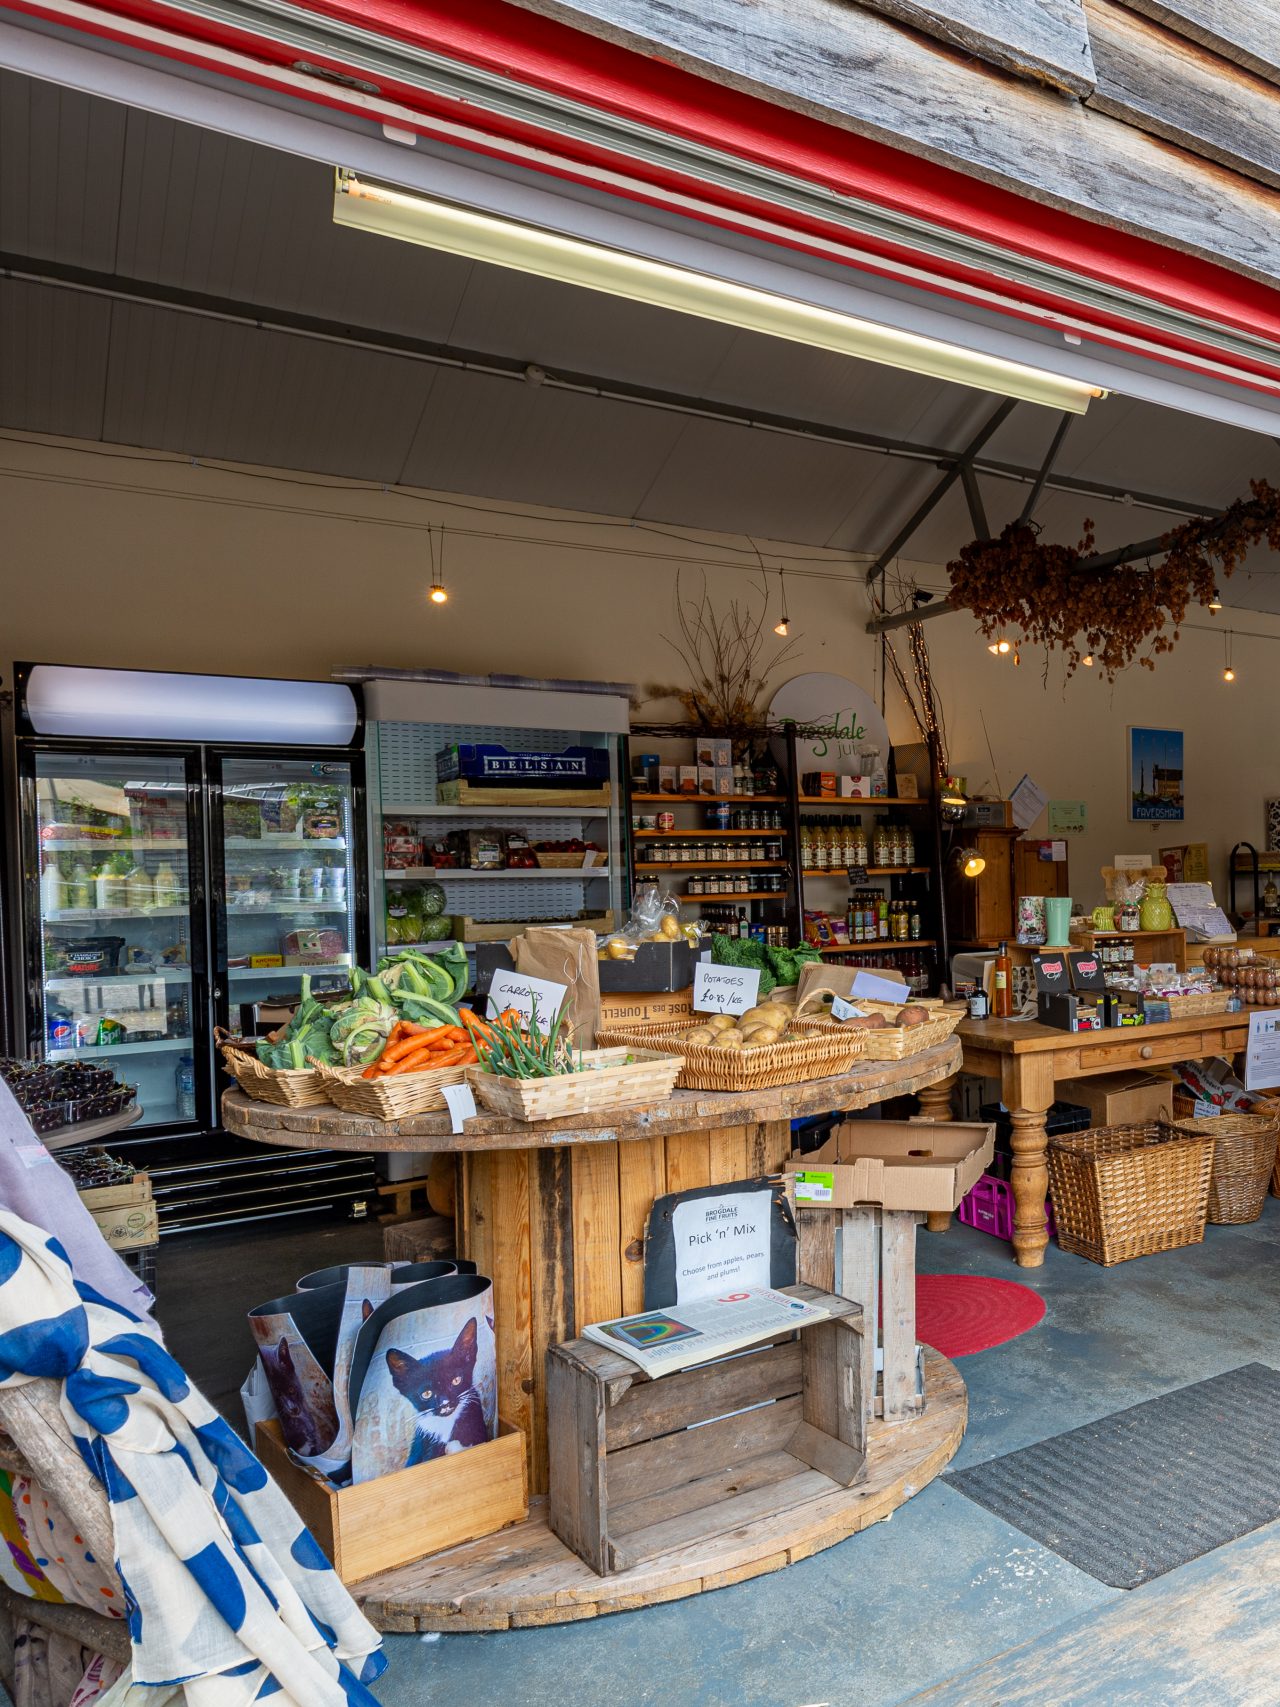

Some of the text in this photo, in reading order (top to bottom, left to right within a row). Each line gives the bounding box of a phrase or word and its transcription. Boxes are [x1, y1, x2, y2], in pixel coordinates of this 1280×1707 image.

[491, 759, 581, 770] BELSAN
[1136, 807, 1181, 819] FAVERSHAM
[703, 973, 744, 986] POTATOES
[499, 984, 543, 1001] CARROTS
[705, 1206, 738, 1217] BROGDALE
[718, 1212, 738, 1220] FRUITS
[689, 1231, 712, 1247] Pick
[733, 1223, 756, 1236] Mix
[682, 1265, 706, 1276] Choose
[707, 1261, 722, 1270] from
